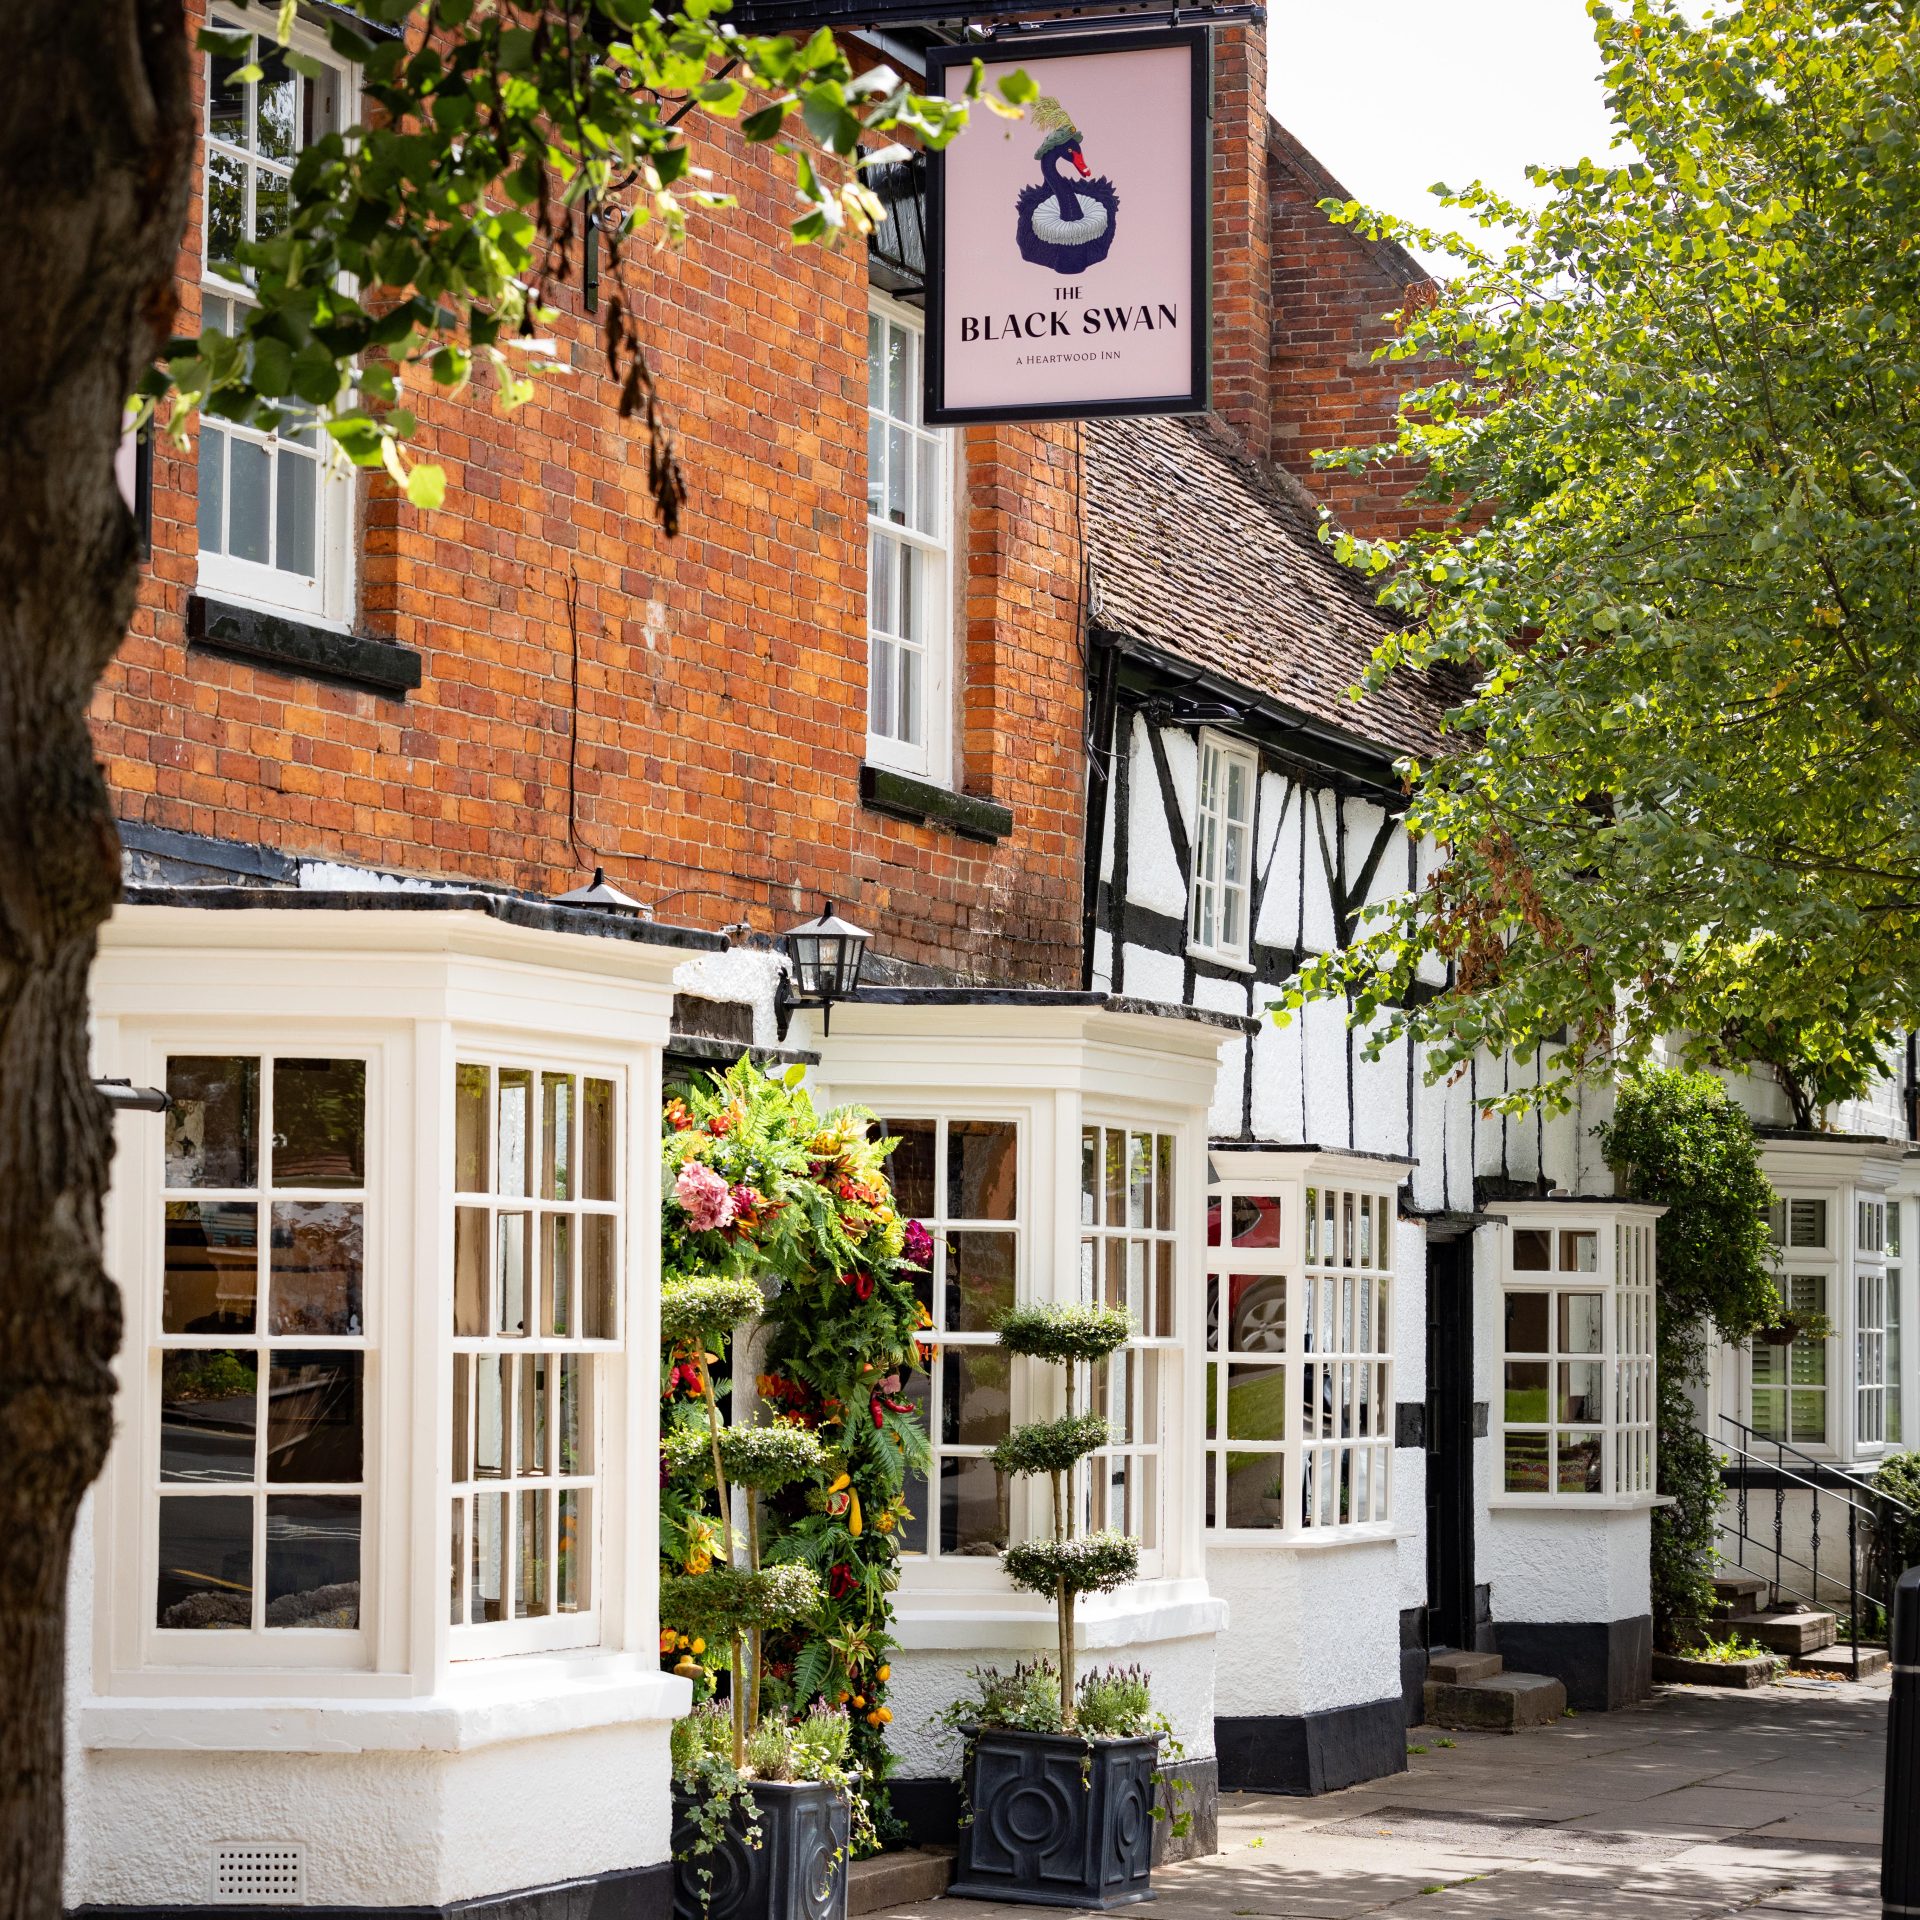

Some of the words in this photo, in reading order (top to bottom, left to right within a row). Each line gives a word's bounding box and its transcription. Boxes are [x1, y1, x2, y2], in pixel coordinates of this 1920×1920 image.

[1053, 286, 1084, 301] THE
[961, 309, 1071, 342] BLACK
[1083, 303, 1177, 335] SWAN
[1016, 357, 1023, 365] A
[1026, 352, 1097, 365] HEARTWOOD
[1101, 350, 1121, 361] INN
